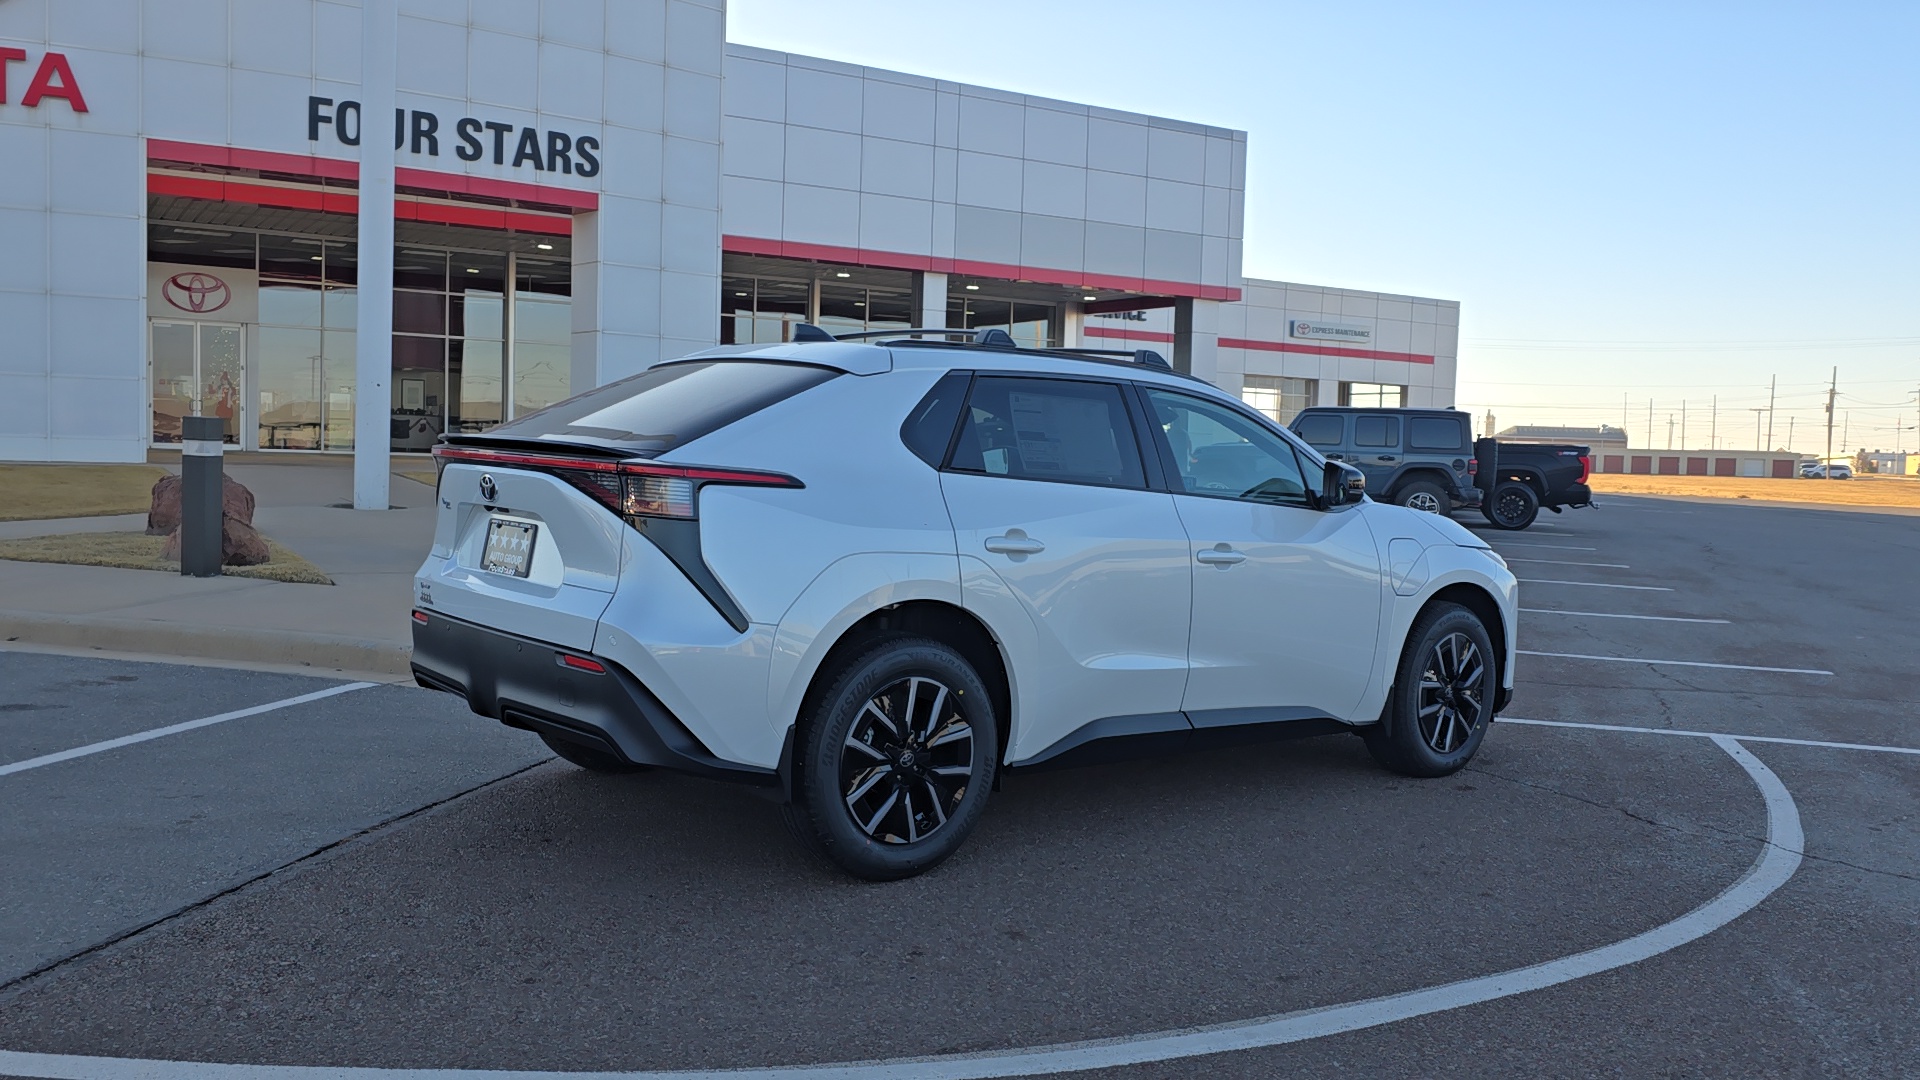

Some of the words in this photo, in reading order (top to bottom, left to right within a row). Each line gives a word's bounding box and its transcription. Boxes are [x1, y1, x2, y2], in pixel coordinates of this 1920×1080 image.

[455, 117, 600, 178] STARS
[1311, 326, 1334, 335] EXPRESS
[1335, 328, 1370, 338] MAINTENANCE
[489, 551, 504, 562] AUTO
[503, 554, 523, 565] GROUP
[821, 667, 880, 768] BRIDGESTONE
